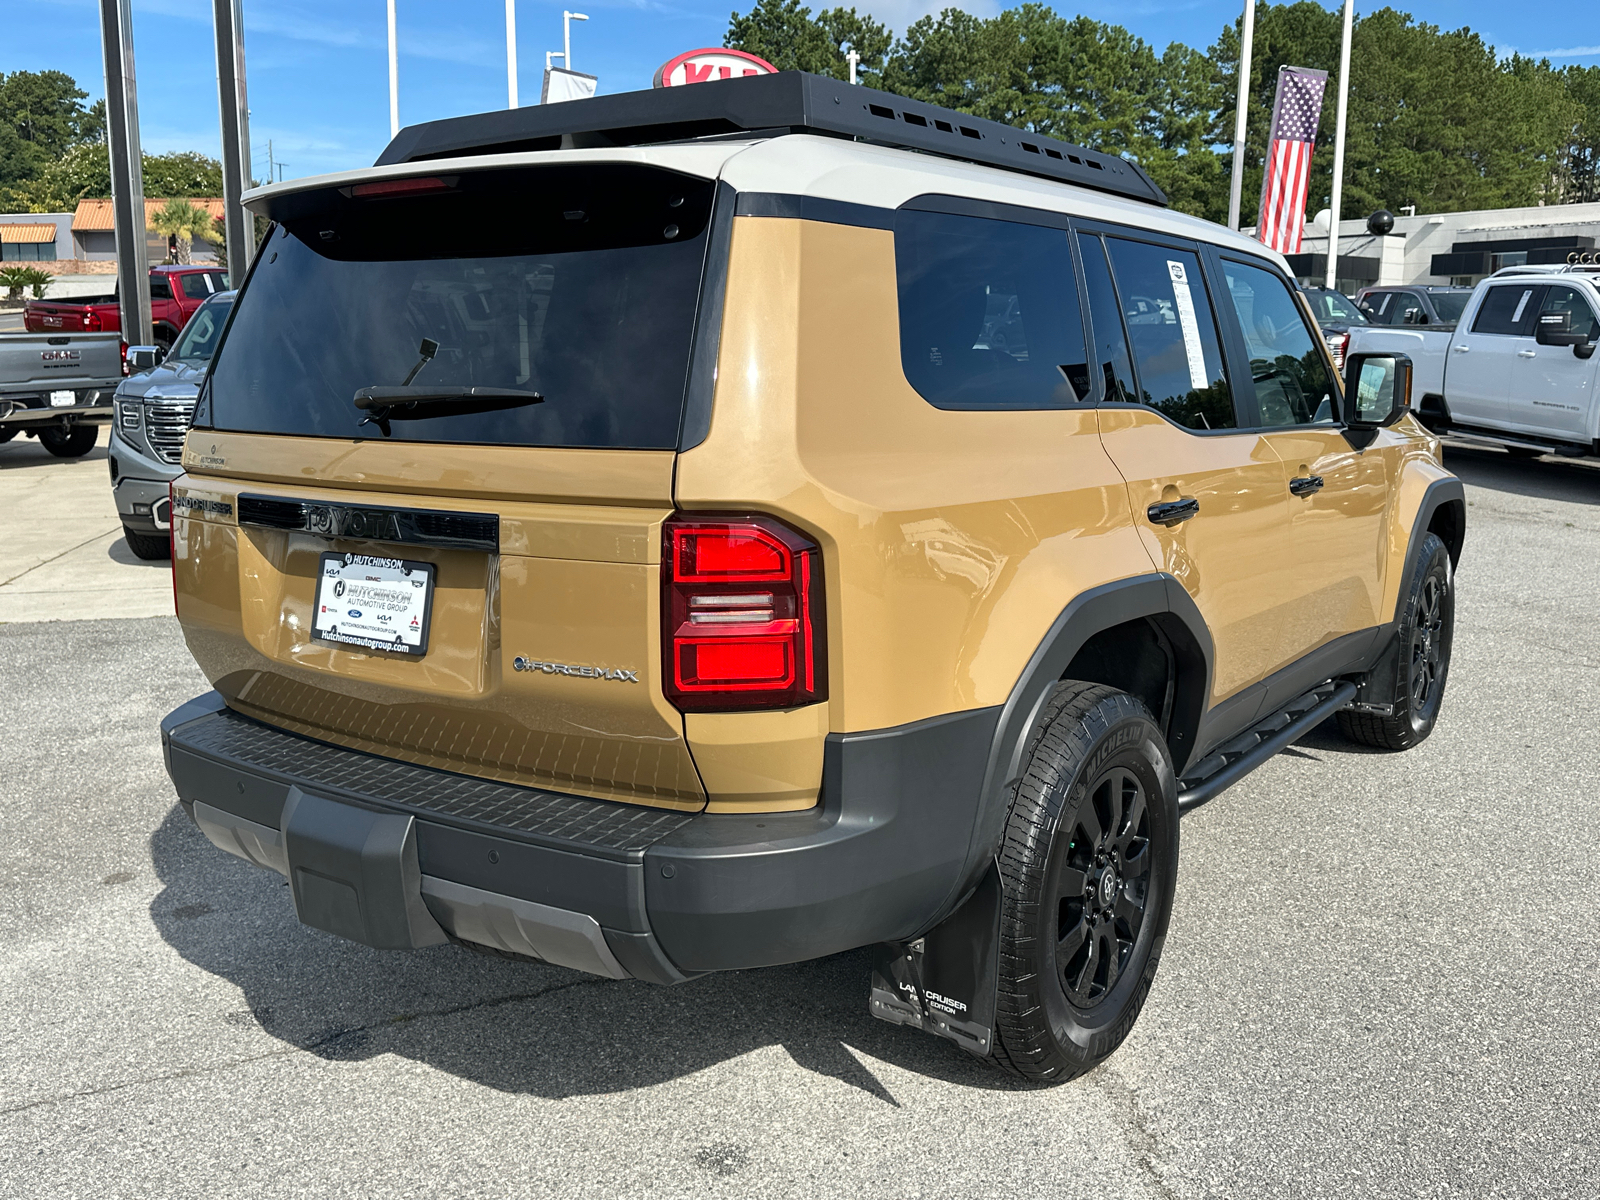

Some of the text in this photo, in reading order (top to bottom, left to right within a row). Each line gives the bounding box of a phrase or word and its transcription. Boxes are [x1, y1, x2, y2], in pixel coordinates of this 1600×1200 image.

[41, 351, 81, 361] GMC
[305, 506, 402, 540] TOYOTA
[354, 554, 403, 569] HUTCHINSON
[347, 584, 412, 605] HUTCHINSON
[347, 598, 408, 613] AUTOMOTIVE GROUP
[349, 610, 362, 618] Ford
[321, 630, 409, 653] Hutchinsonautogroup.com
[1086, 726, 1141, 782] MICHELIN
[899, 981, 967, 1013] LAN CRUISER
[930, 1000, 956, 1015] EDITION
